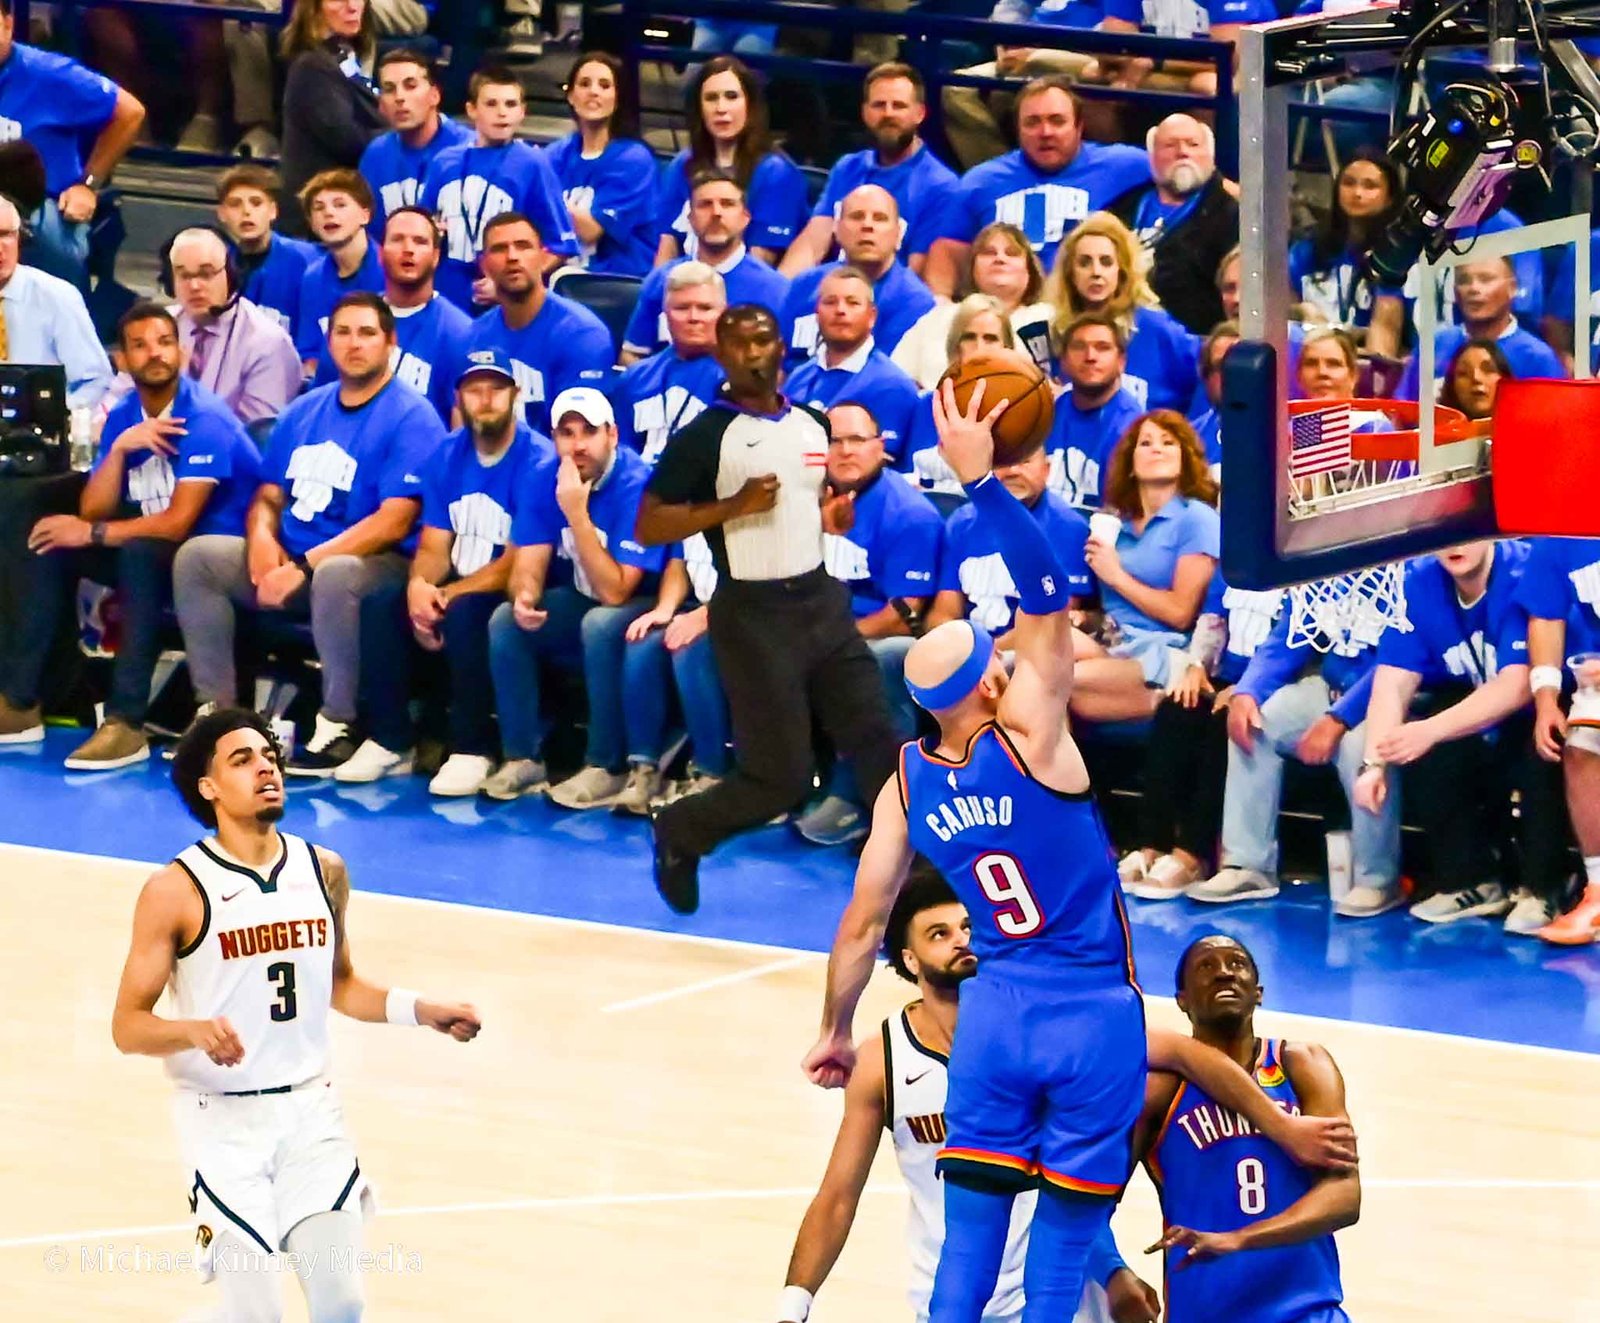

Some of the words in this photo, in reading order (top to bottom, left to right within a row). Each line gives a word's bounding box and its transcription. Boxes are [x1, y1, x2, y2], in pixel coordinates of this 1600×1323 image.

[925, 795, 1013, 842] CARUSO
[973, 851, 1044, 937] 9
[218, 918, 327, 960] NUGGETS
[267, 961, 297, 1022] 3
[1236, 1157, 1266, 1216] 8
